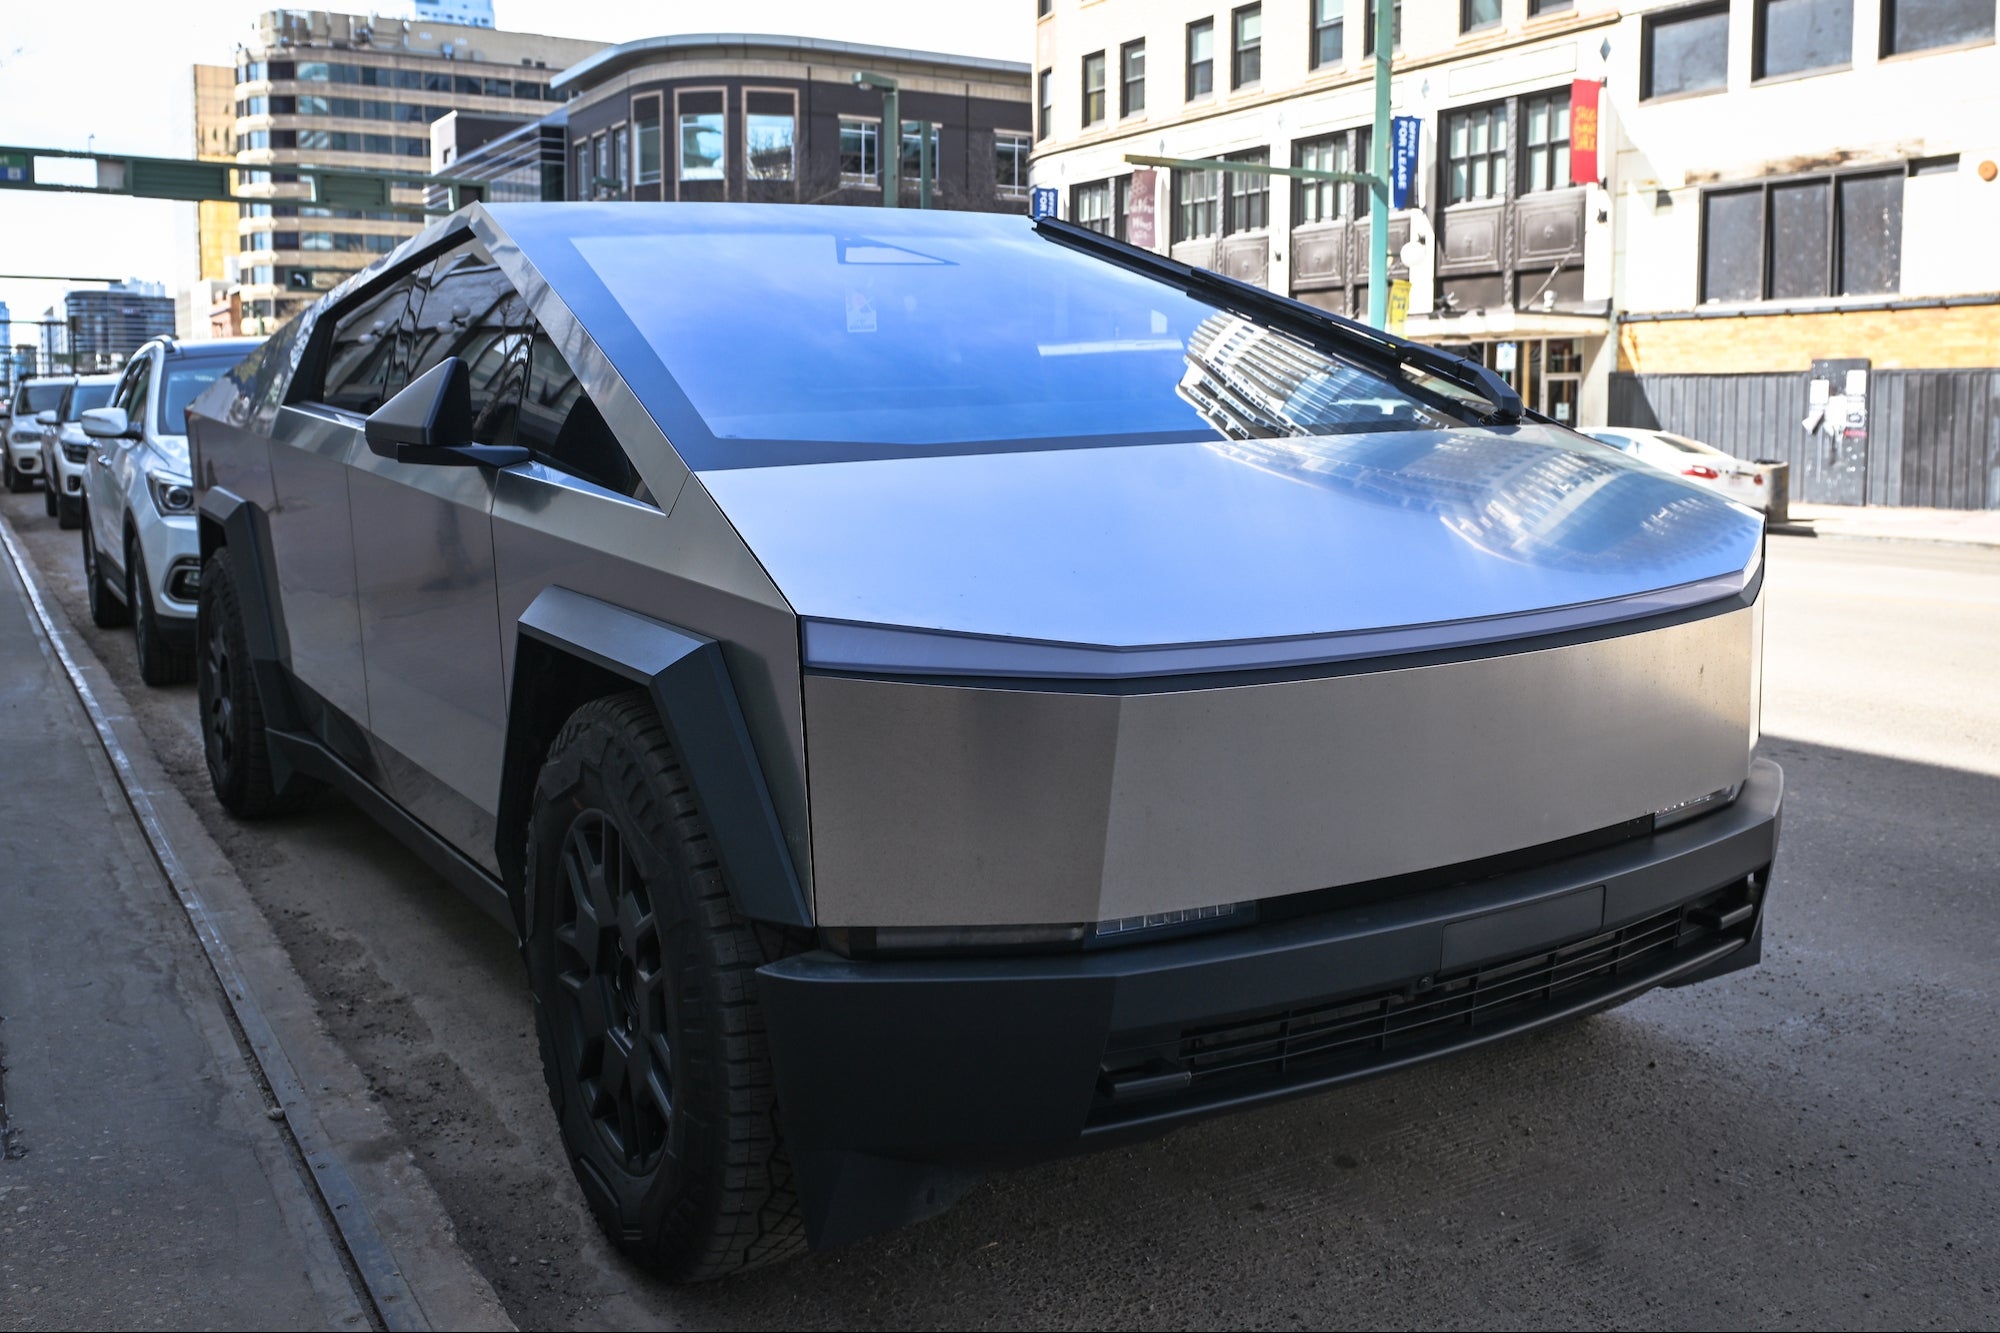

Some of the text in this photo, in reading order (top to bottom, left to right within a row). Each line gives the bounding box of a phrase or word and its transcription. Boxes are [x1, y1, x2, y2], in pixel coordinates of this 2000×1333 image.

[1398, 120, 1408, 190] FOR LEASE
[1408, 121, 1416, 157] OFFICE
[1039, 191, 1047, 211] FOR
